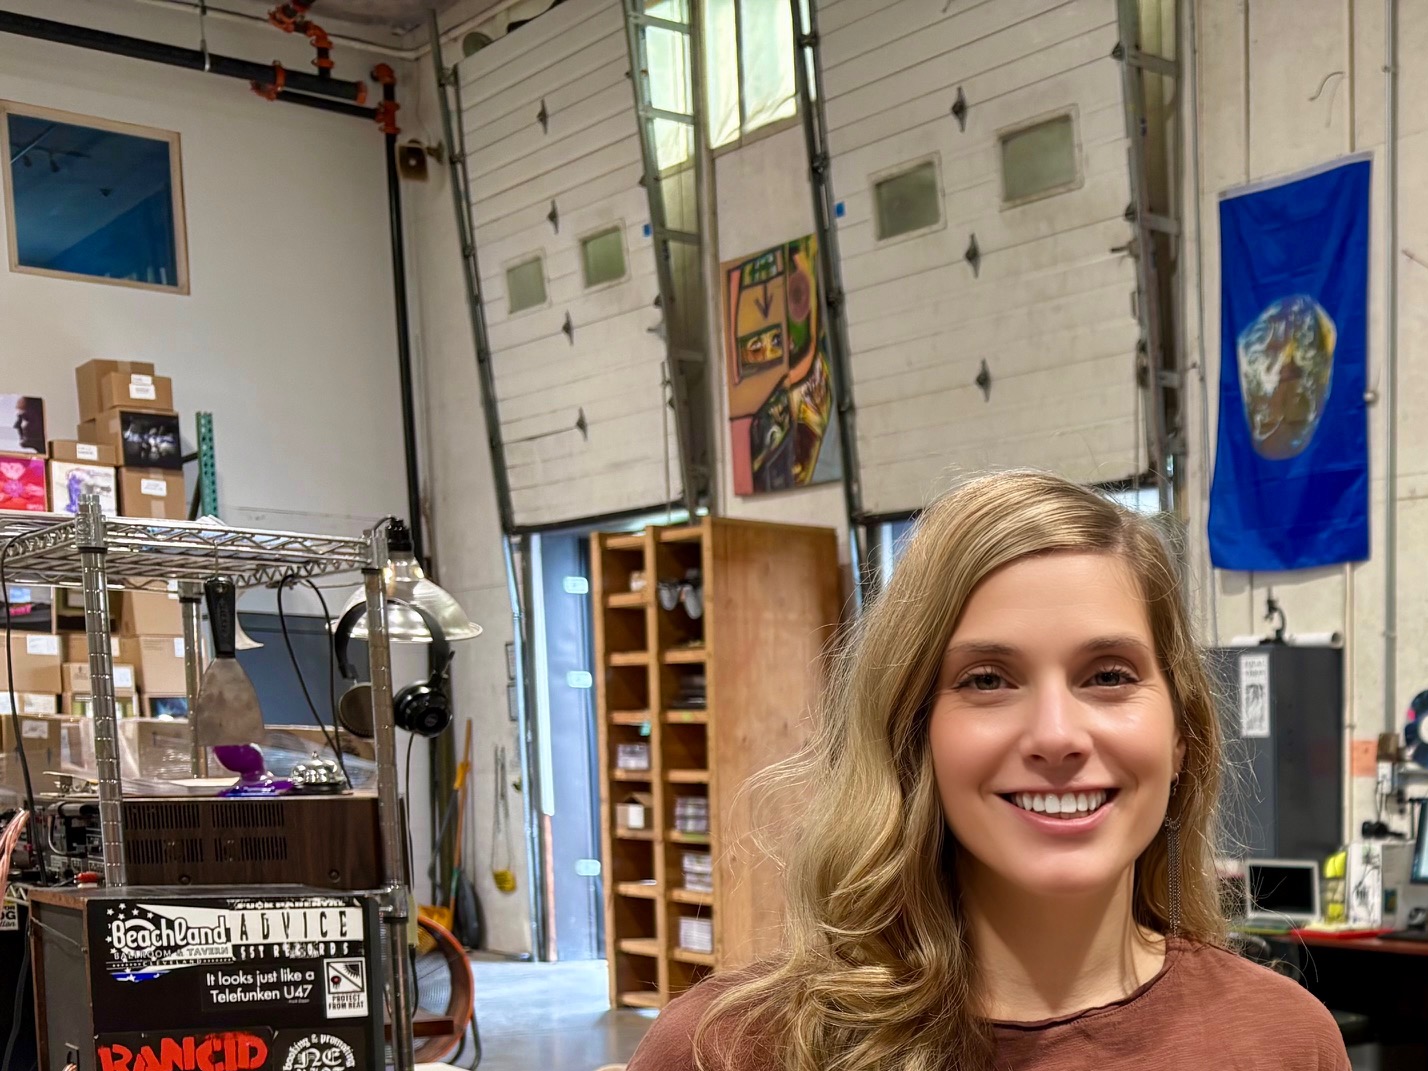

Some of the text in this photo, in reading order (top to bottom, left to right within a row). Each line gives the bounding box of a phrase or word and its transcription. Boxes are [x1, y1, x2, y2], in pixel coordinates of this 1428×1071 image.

[112, 915, 227, 948] Beachland
[240, 910, 347, 941] ADVICE
[114, 949, 172, 960] BALLROOM
[186, 946, 229, 956] TAVERN
[143, 958, 202, 967] CLEVELAND
[206, 967, 315, 987] It looks just like a
[210, 984, 313, 1004] Telefunken U47
[332, 994, 360, 1002] PROTECT
[328, 1002, 346, 1010] FROM
[282, 1037, 311, 1071] booking
